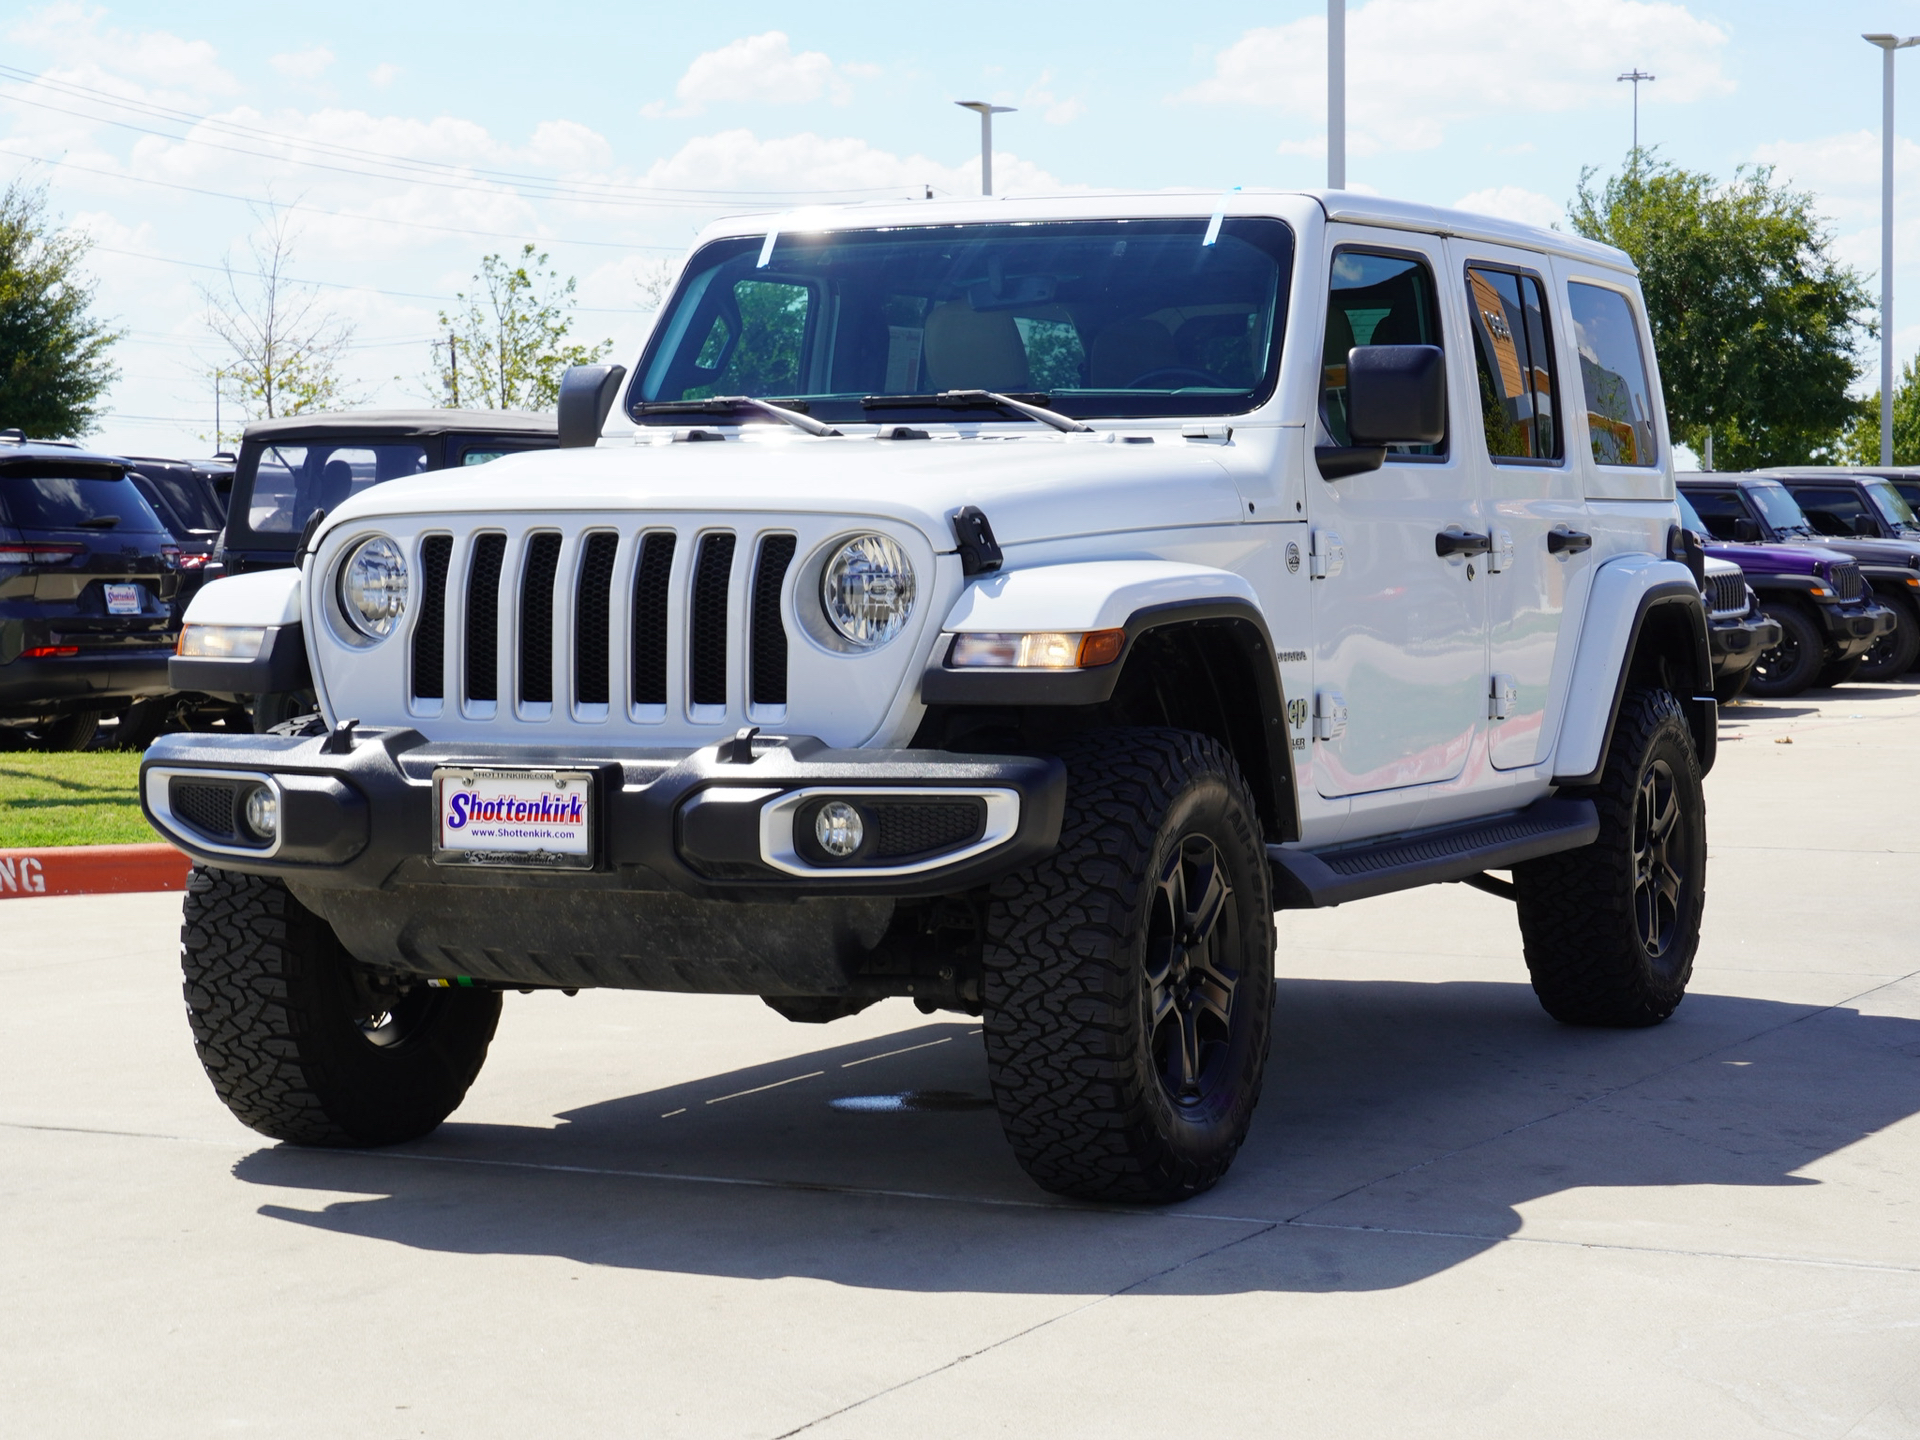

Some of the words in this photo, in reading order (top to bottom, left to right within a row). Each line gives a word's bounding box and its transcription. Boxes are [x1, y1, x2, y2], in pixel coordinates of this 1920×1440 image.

[1276, 650, 1308, 662] AHARA
[1287, 698, 1309, 729] ep
[473, 771, 554, 780] SHOTTENKIRK.COM
[448, 792, 584, 829] Shottenkirk
[471, 828, 575, 839] www.Shottenkirk.com
